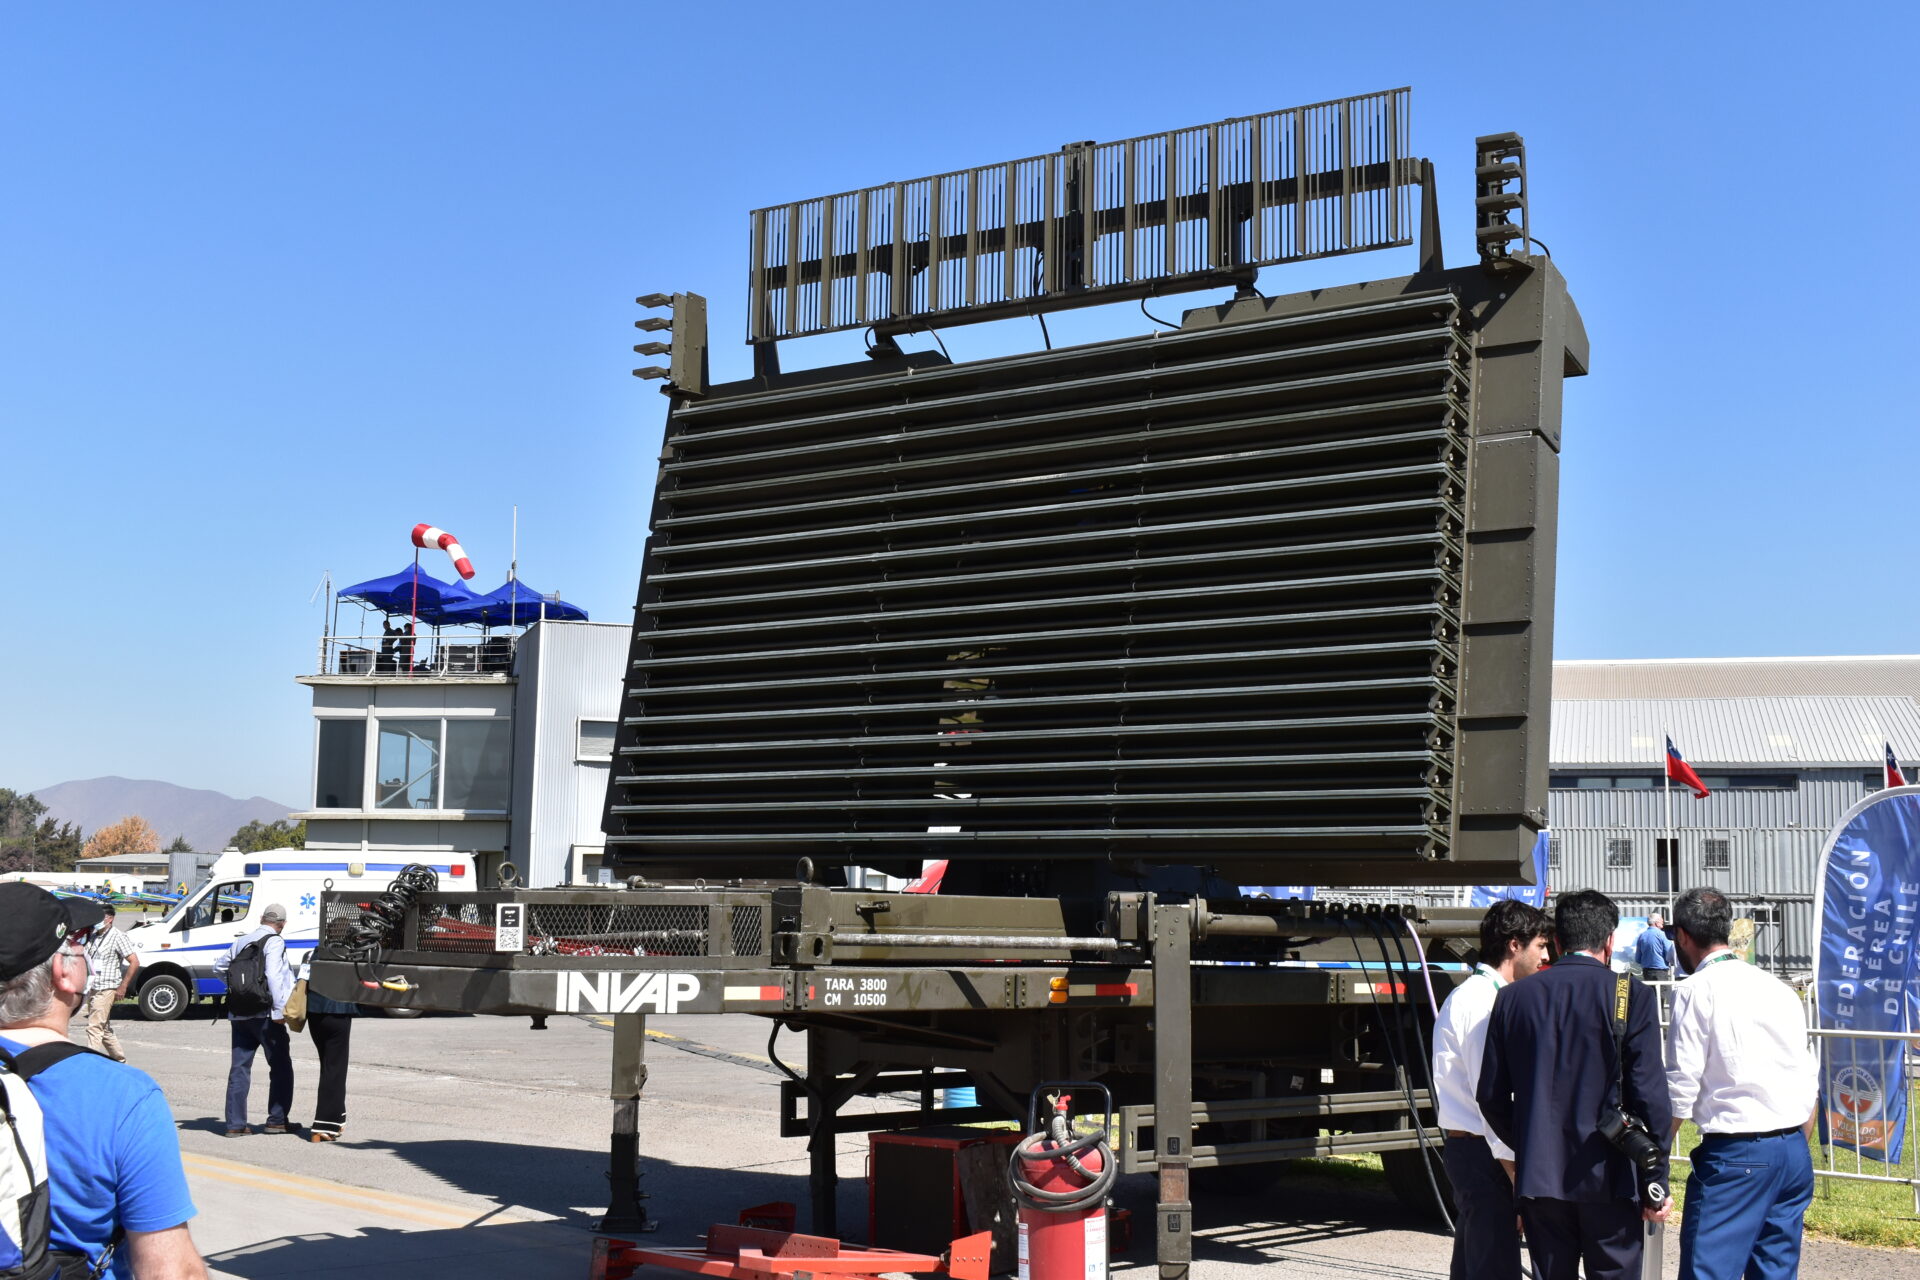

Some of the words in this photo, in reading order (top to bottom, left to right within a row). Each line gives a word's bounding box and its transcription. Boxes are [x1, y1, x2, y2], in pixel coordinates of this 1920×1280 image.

[1888, 881, 1919, 965] CHILE
[1835, 850, 1871, 1031] FEDERACIÓN
[1863, 898, 1892, 992] AÉREA
[556, 971, 701, 1013] INVAP
[824, 977, 855, 991] TARA
[860, 978, 887, 991] 3800
[1618, 979, 1628, 997] D750
[1883, 979, 1902, 1016] DE
[824, 992, 842, 1006] CM
[853, 993, 887, 1006] 10500
[1617, 998, 1626, 1019] Nikon
[1837, 1119, 1876, 1135] VOLADO
